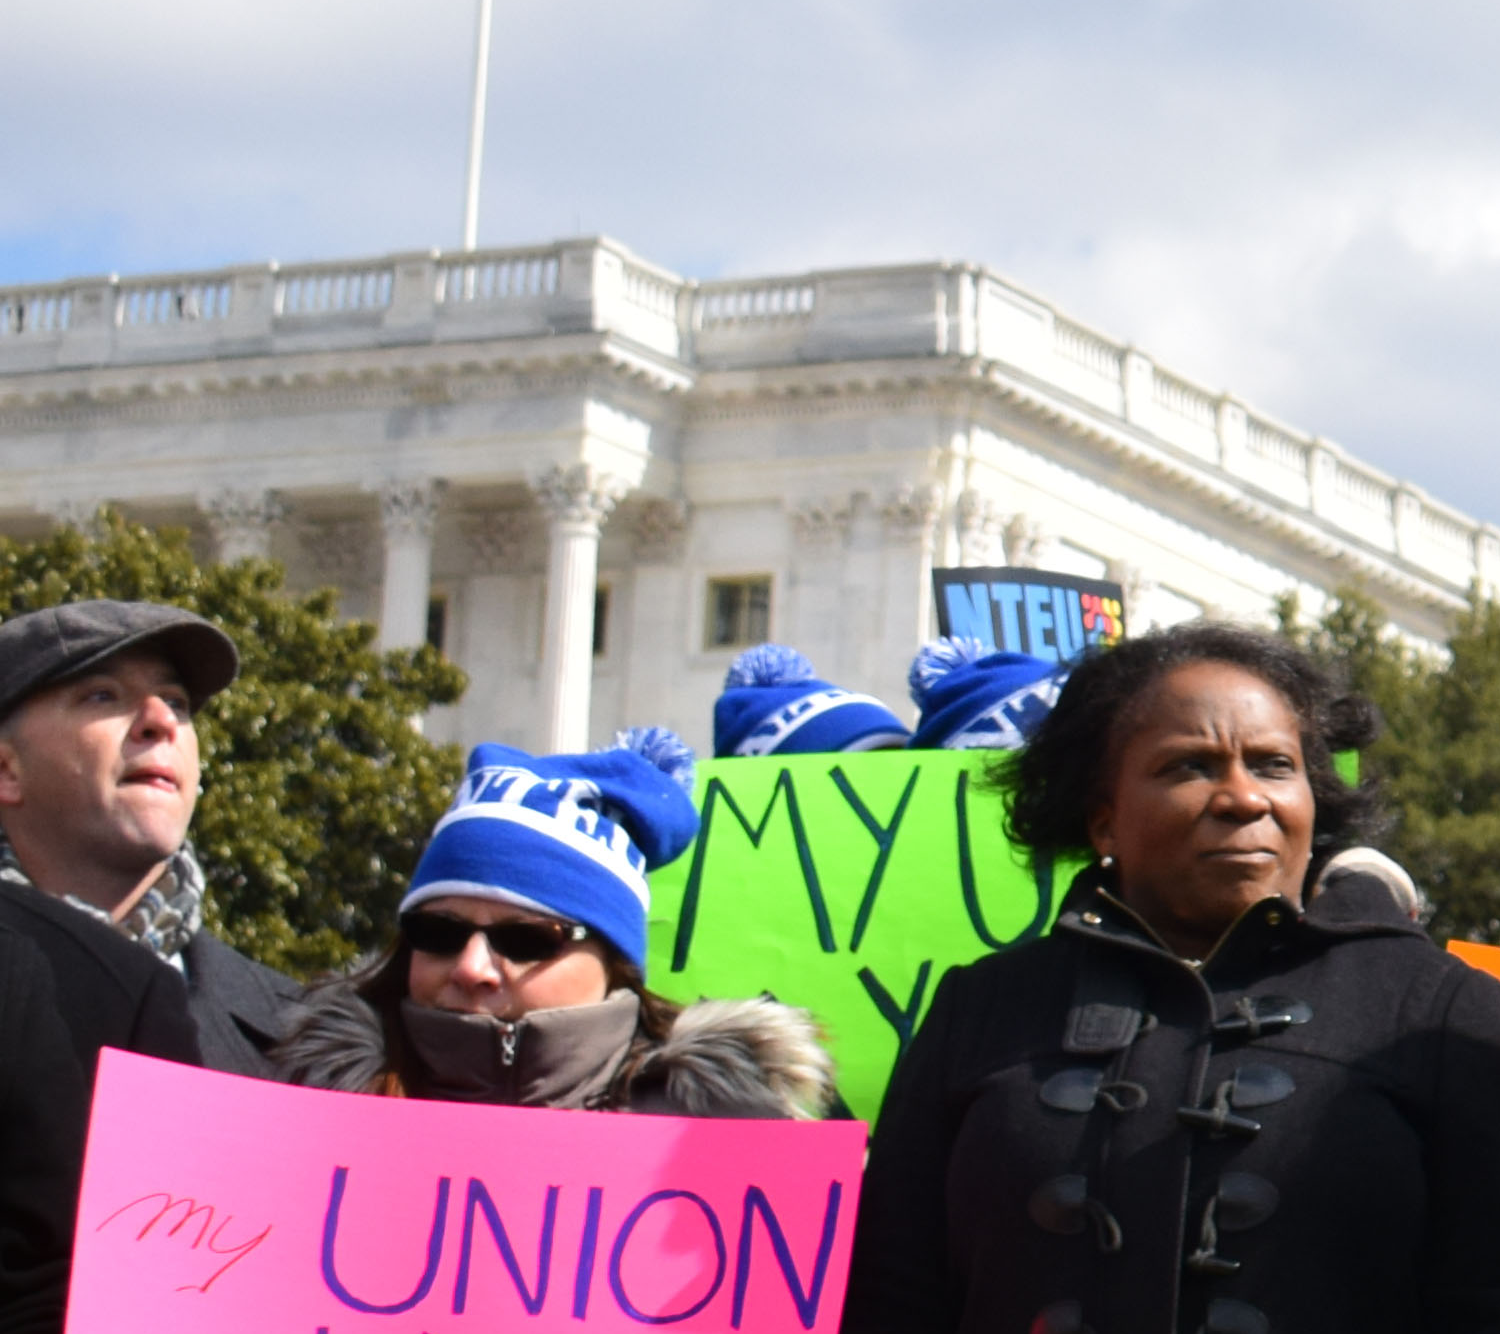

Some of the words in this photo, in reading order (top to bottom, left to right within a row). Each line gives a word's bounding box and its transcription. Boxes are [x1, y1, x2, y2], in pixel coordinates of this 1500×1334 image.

[944, 581, 1085, 664] NTEU
[671, 766, 921, 972] MY
[95, 1192, 273, 1294] my
[322, 1166, 843, 1330] UNION
